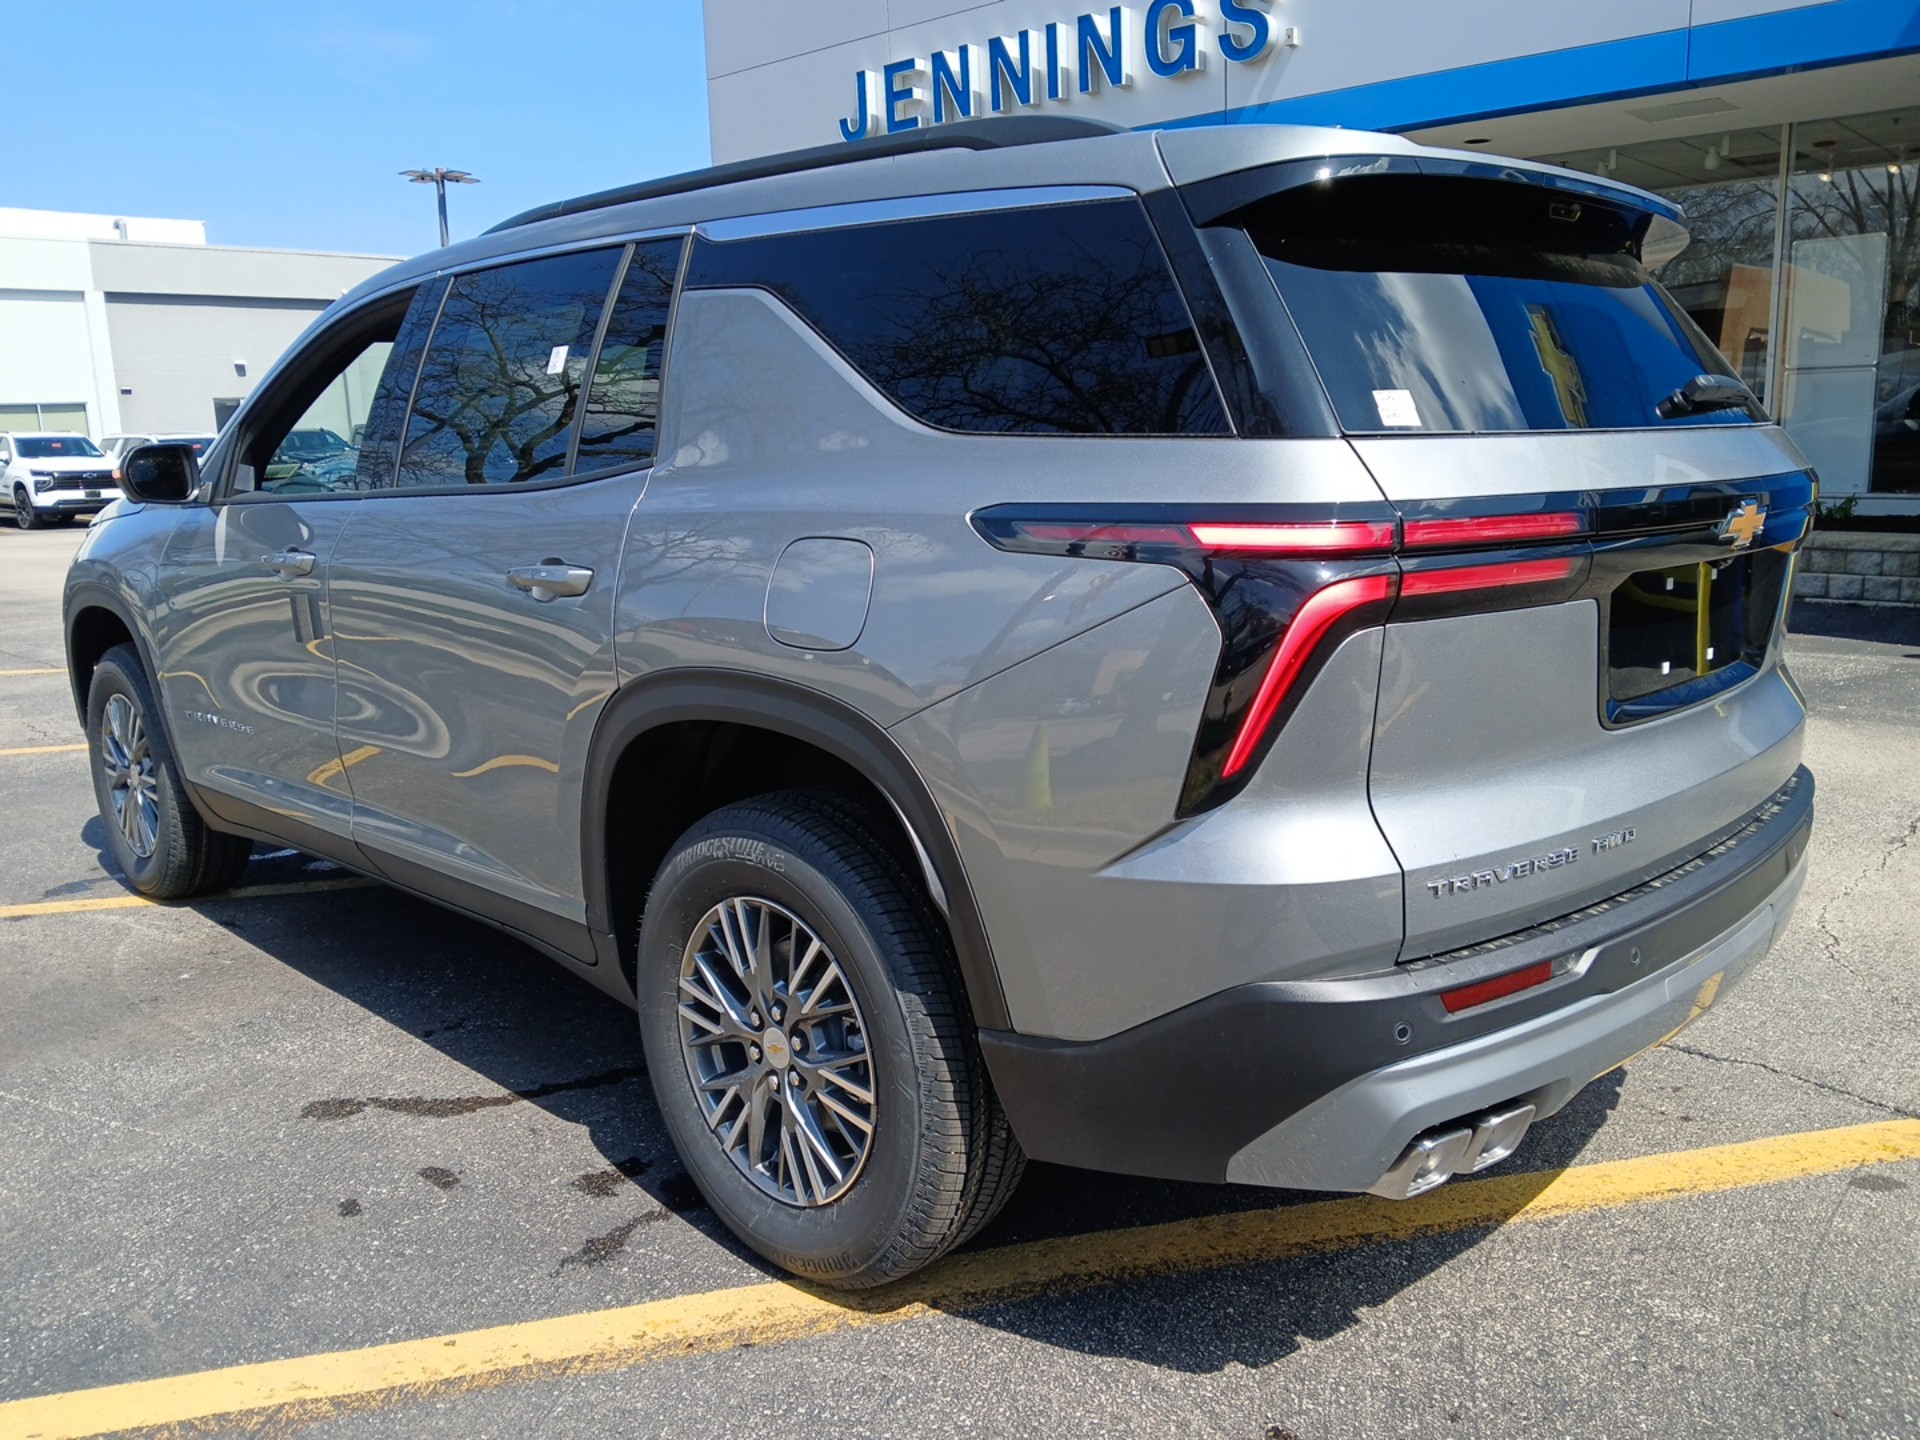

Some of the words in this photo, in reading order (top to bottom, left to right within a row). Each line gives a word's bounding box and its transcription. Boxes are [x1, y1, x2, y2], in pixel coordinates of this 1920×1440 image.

[838, 0, 1274, 143] JENNINGS
[1427, 846, 1580, 899] TRAVERSE
[1592, 826, 1636, 855] AWD
